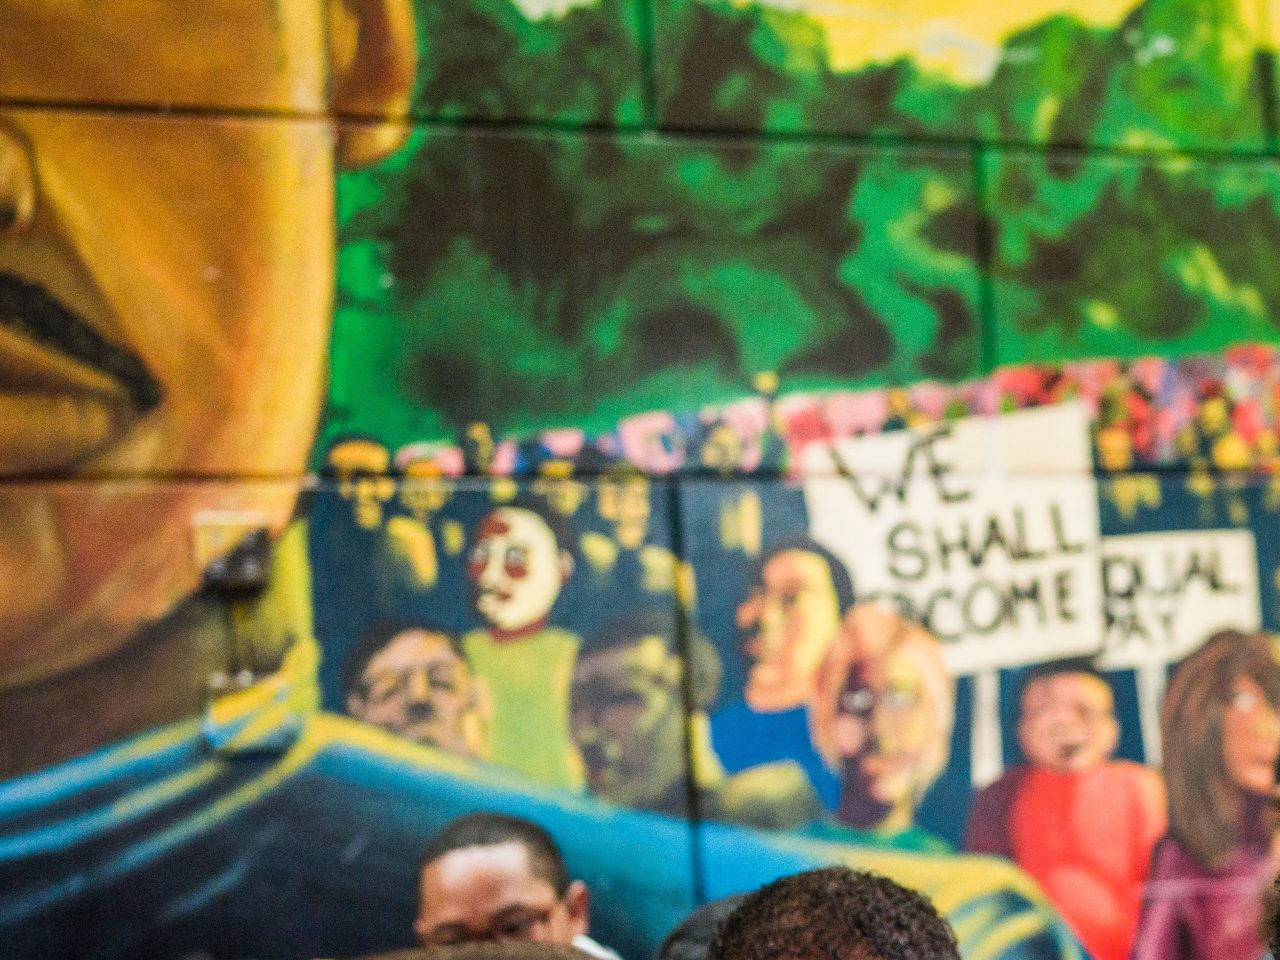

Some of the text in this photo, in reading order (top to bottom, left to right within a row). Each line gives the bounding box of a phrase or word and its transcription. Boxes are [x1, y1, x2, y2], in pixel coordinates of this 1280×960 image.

[826, 424, 972, 513] WE
[886, 503, 1085, 581] SHALL
[860, 567, 1077, 643] COME
